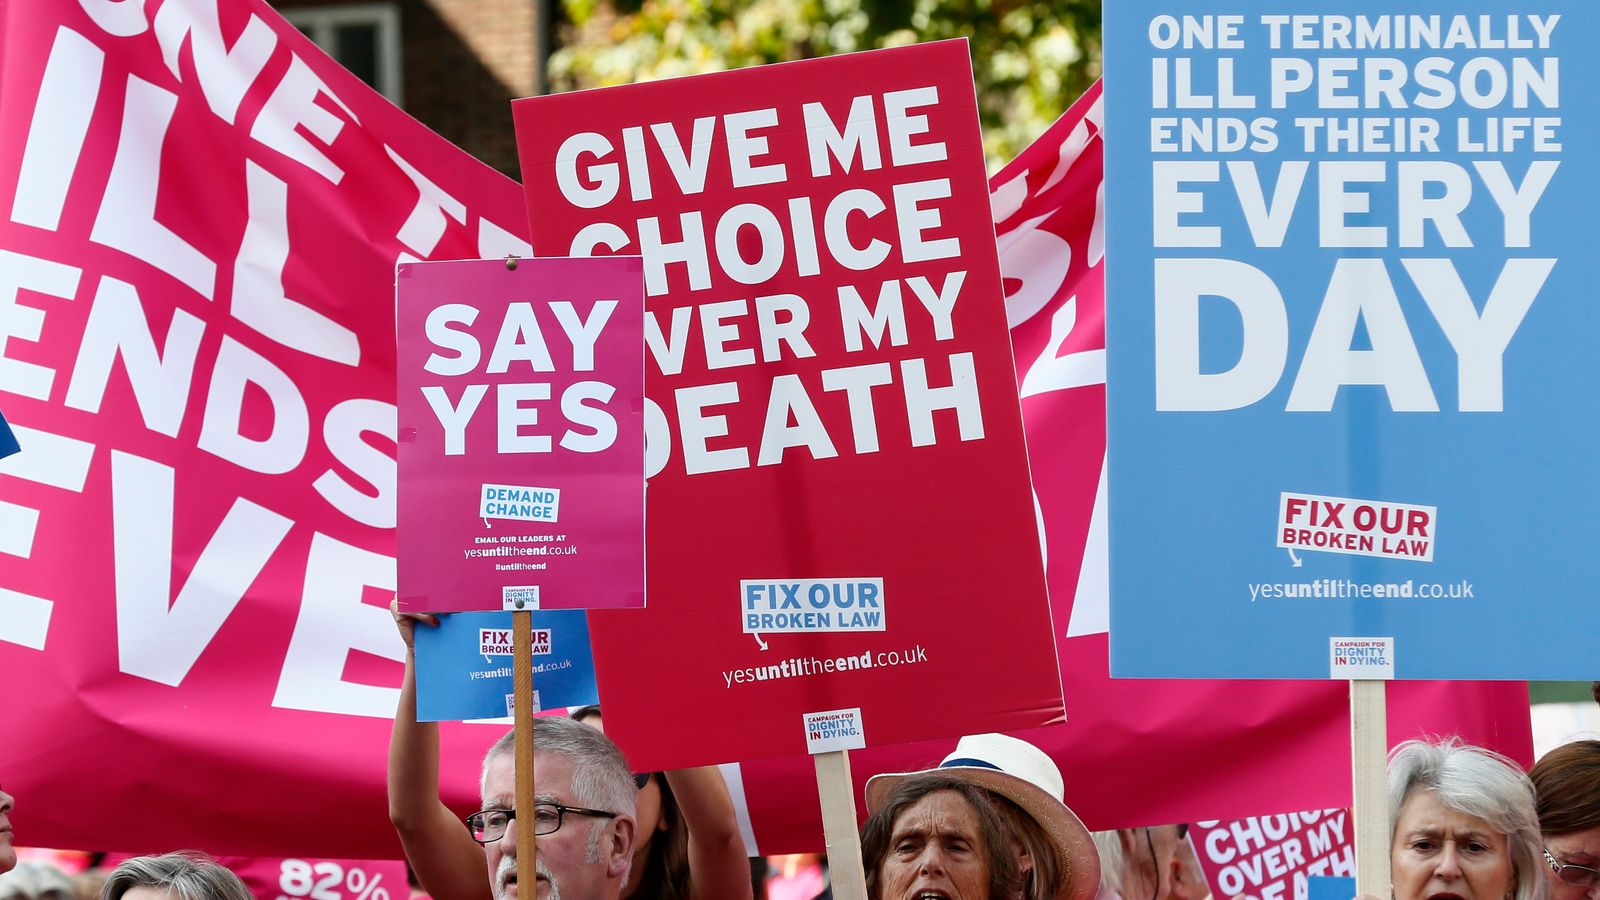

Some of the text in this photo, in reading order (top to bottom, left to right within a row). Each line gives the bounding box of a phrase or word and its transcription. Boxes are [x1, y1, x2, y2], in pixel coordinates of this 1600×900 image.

[1148, 14, 1562, 49] ONE TERMINALLY
[1152, 56, 1560, 110] ILL PERSON
[555, 107, 787, 208] GIVE
[802, 85, 949, 178] ME
[1150, 117, 1562, 154] ENDS THEIR LIFE
[9, 24, 361, 368] ILL
[1153, 160, 1561, 248] EVERY
[645, 293, 816, 376] VER
[837, 270, 968, 353] MY
[1154, 257, 1558, 412] DAY
[424, 300, 619, 377] SAY
[421, 381, 618, 457] YES
[486, 487, 555, 504] DEMAND
[485, 502, 553, 519] CHANGE
[1285, 497, 1430, 537] FIX OUR
[464, 544, 577, 560] yesuntiltheend.co.uk
[474, 534, 567, 544] EMAIL OUR LEADERS AT
[1282, 527, 1429, 557] BROKEN LAW
[495, 562, 547, 571] #untiltheend
[746, 582, 879, 610] FIX OUR
[1248, 578, 1474, 602] yesuntiltheend.co.uk
[747, 611, 881, 629] BROKEN LAW
[482, 631, 509, 645] FIX
[533, 645, 549, 653] AW
[1334, 648, 1385, 657] DIGNITY
[722, 644, 928, 689] yesuntiltheend.co.uk
[1334, 656, 1390, 666] IN DYING.
[807, 714, 840, 723] CAMPAIGN
[808, 718, 854, 732] DIGNITY
[809, 727, 860, 741] IN DYING.
[1217, 812, 1346, 897] OVER MY
[278, 858, 391, 900] 82%
